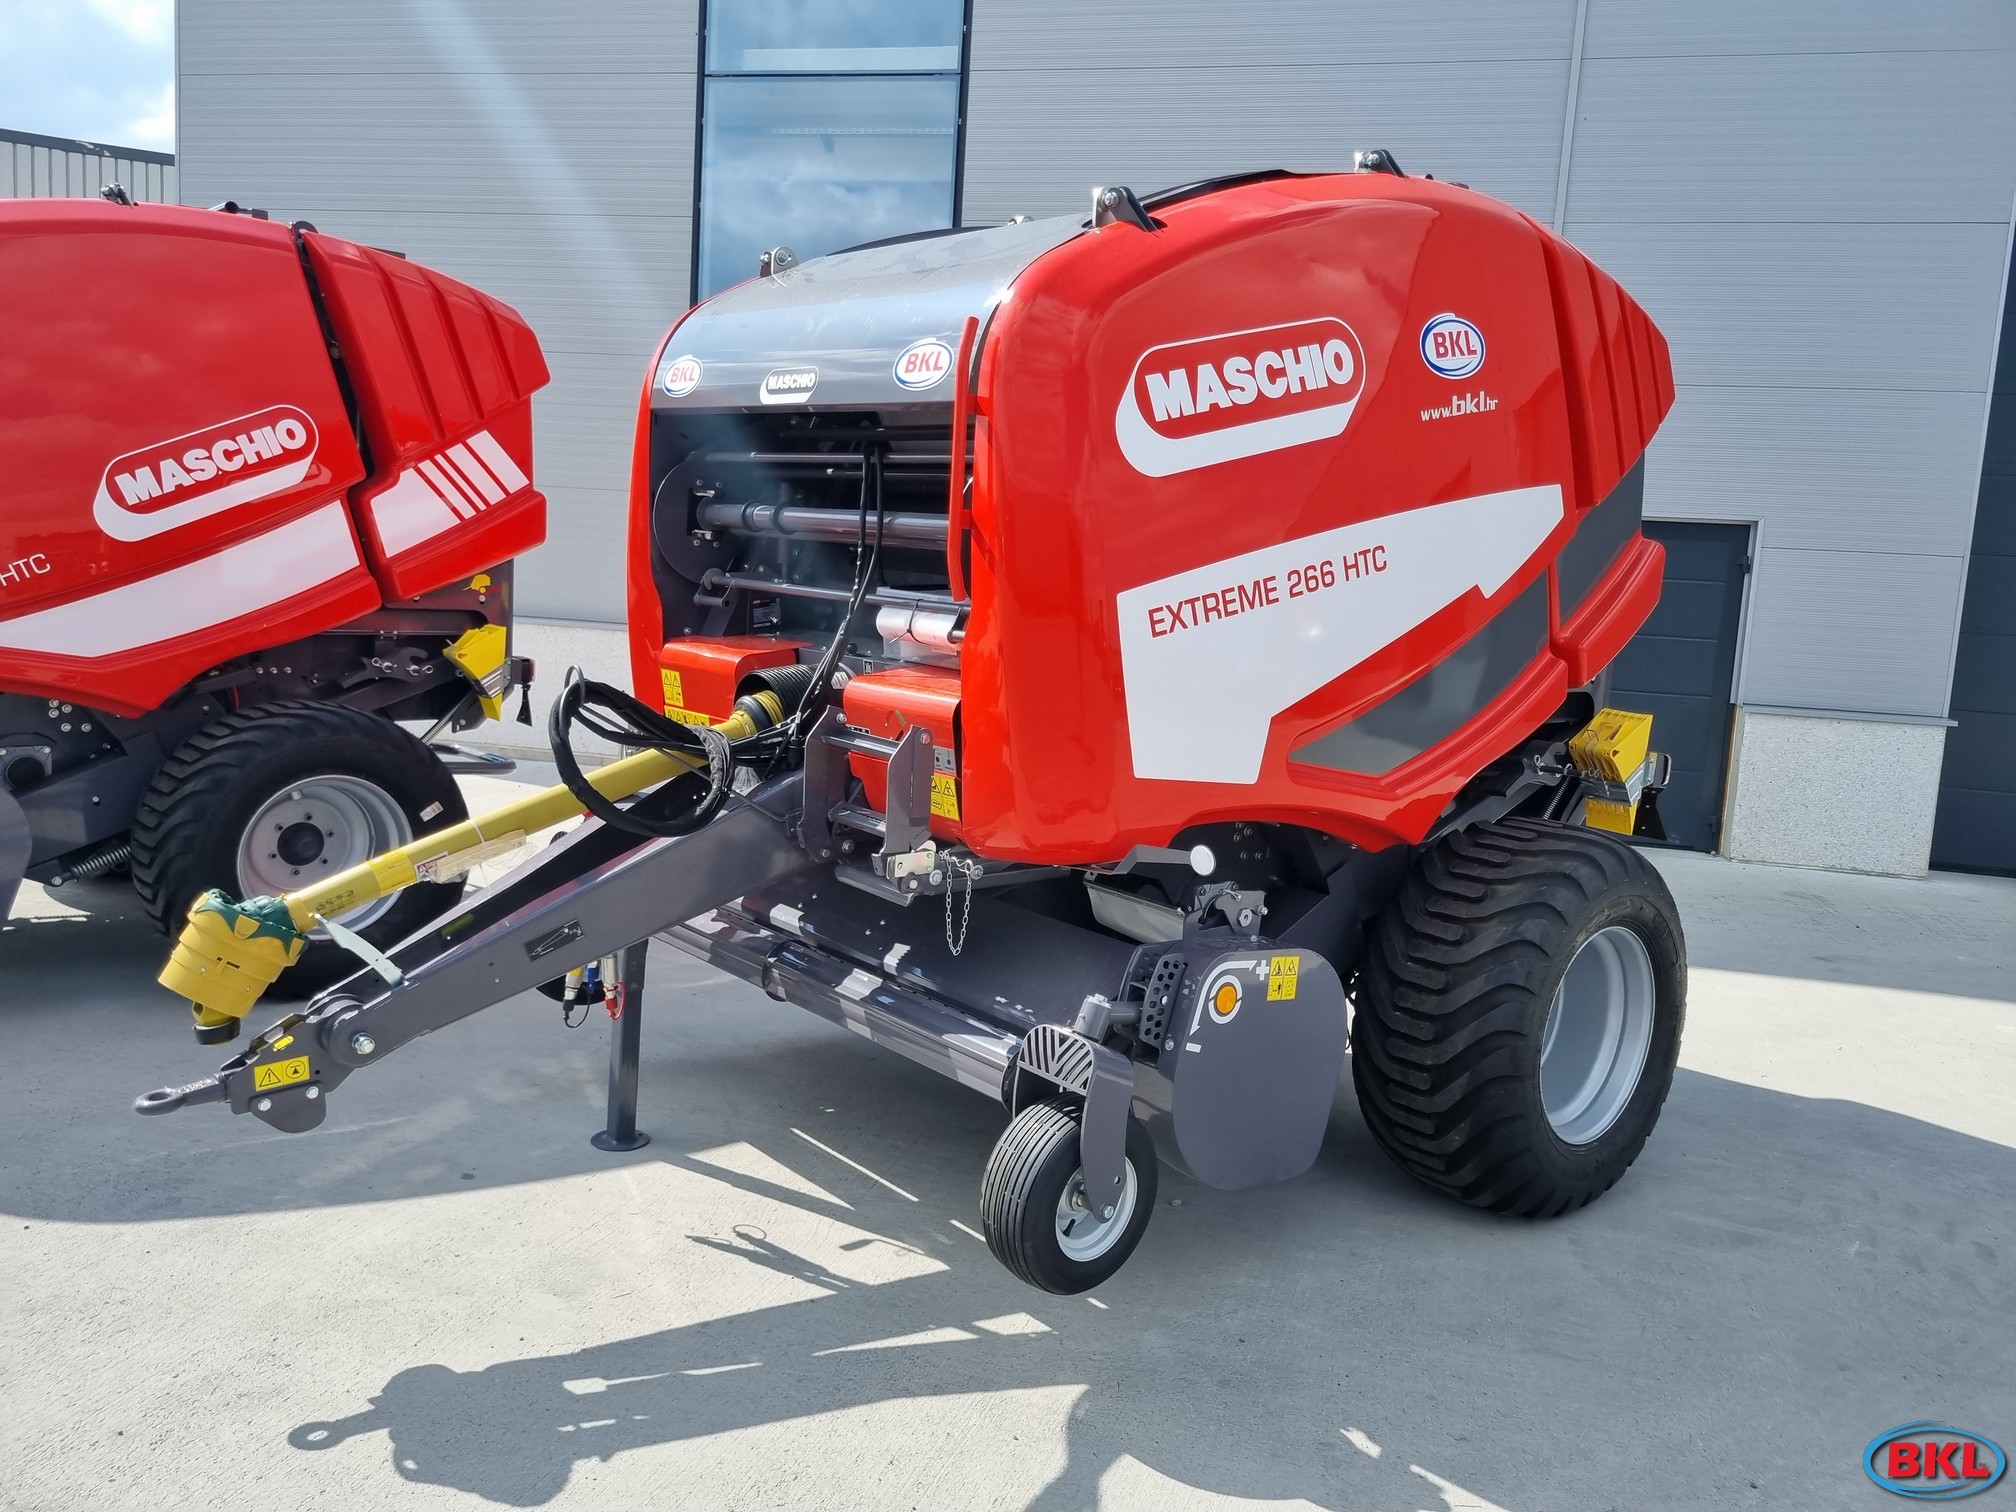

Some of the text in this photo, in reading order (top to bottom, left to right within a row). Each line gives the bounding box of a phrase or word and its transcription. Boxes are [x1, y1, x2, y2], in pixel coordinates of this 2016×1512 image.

[1433, 330, 1477, 359] BKL
[670, 364, 697, 384] BKL
[904, 352, 944, 373] BKL
[767, 372, 815, 391] MASCHIO
[1145, 338, 1355, 422] MASCHIO
[1420, 391, 1498, 421] www.bkl.hr
[113, 418, 307, 506] MASCHIO
[0, 553, 51, 586] HTC
[1147, 544, 1388, 638] EXTREME 266 HTC
